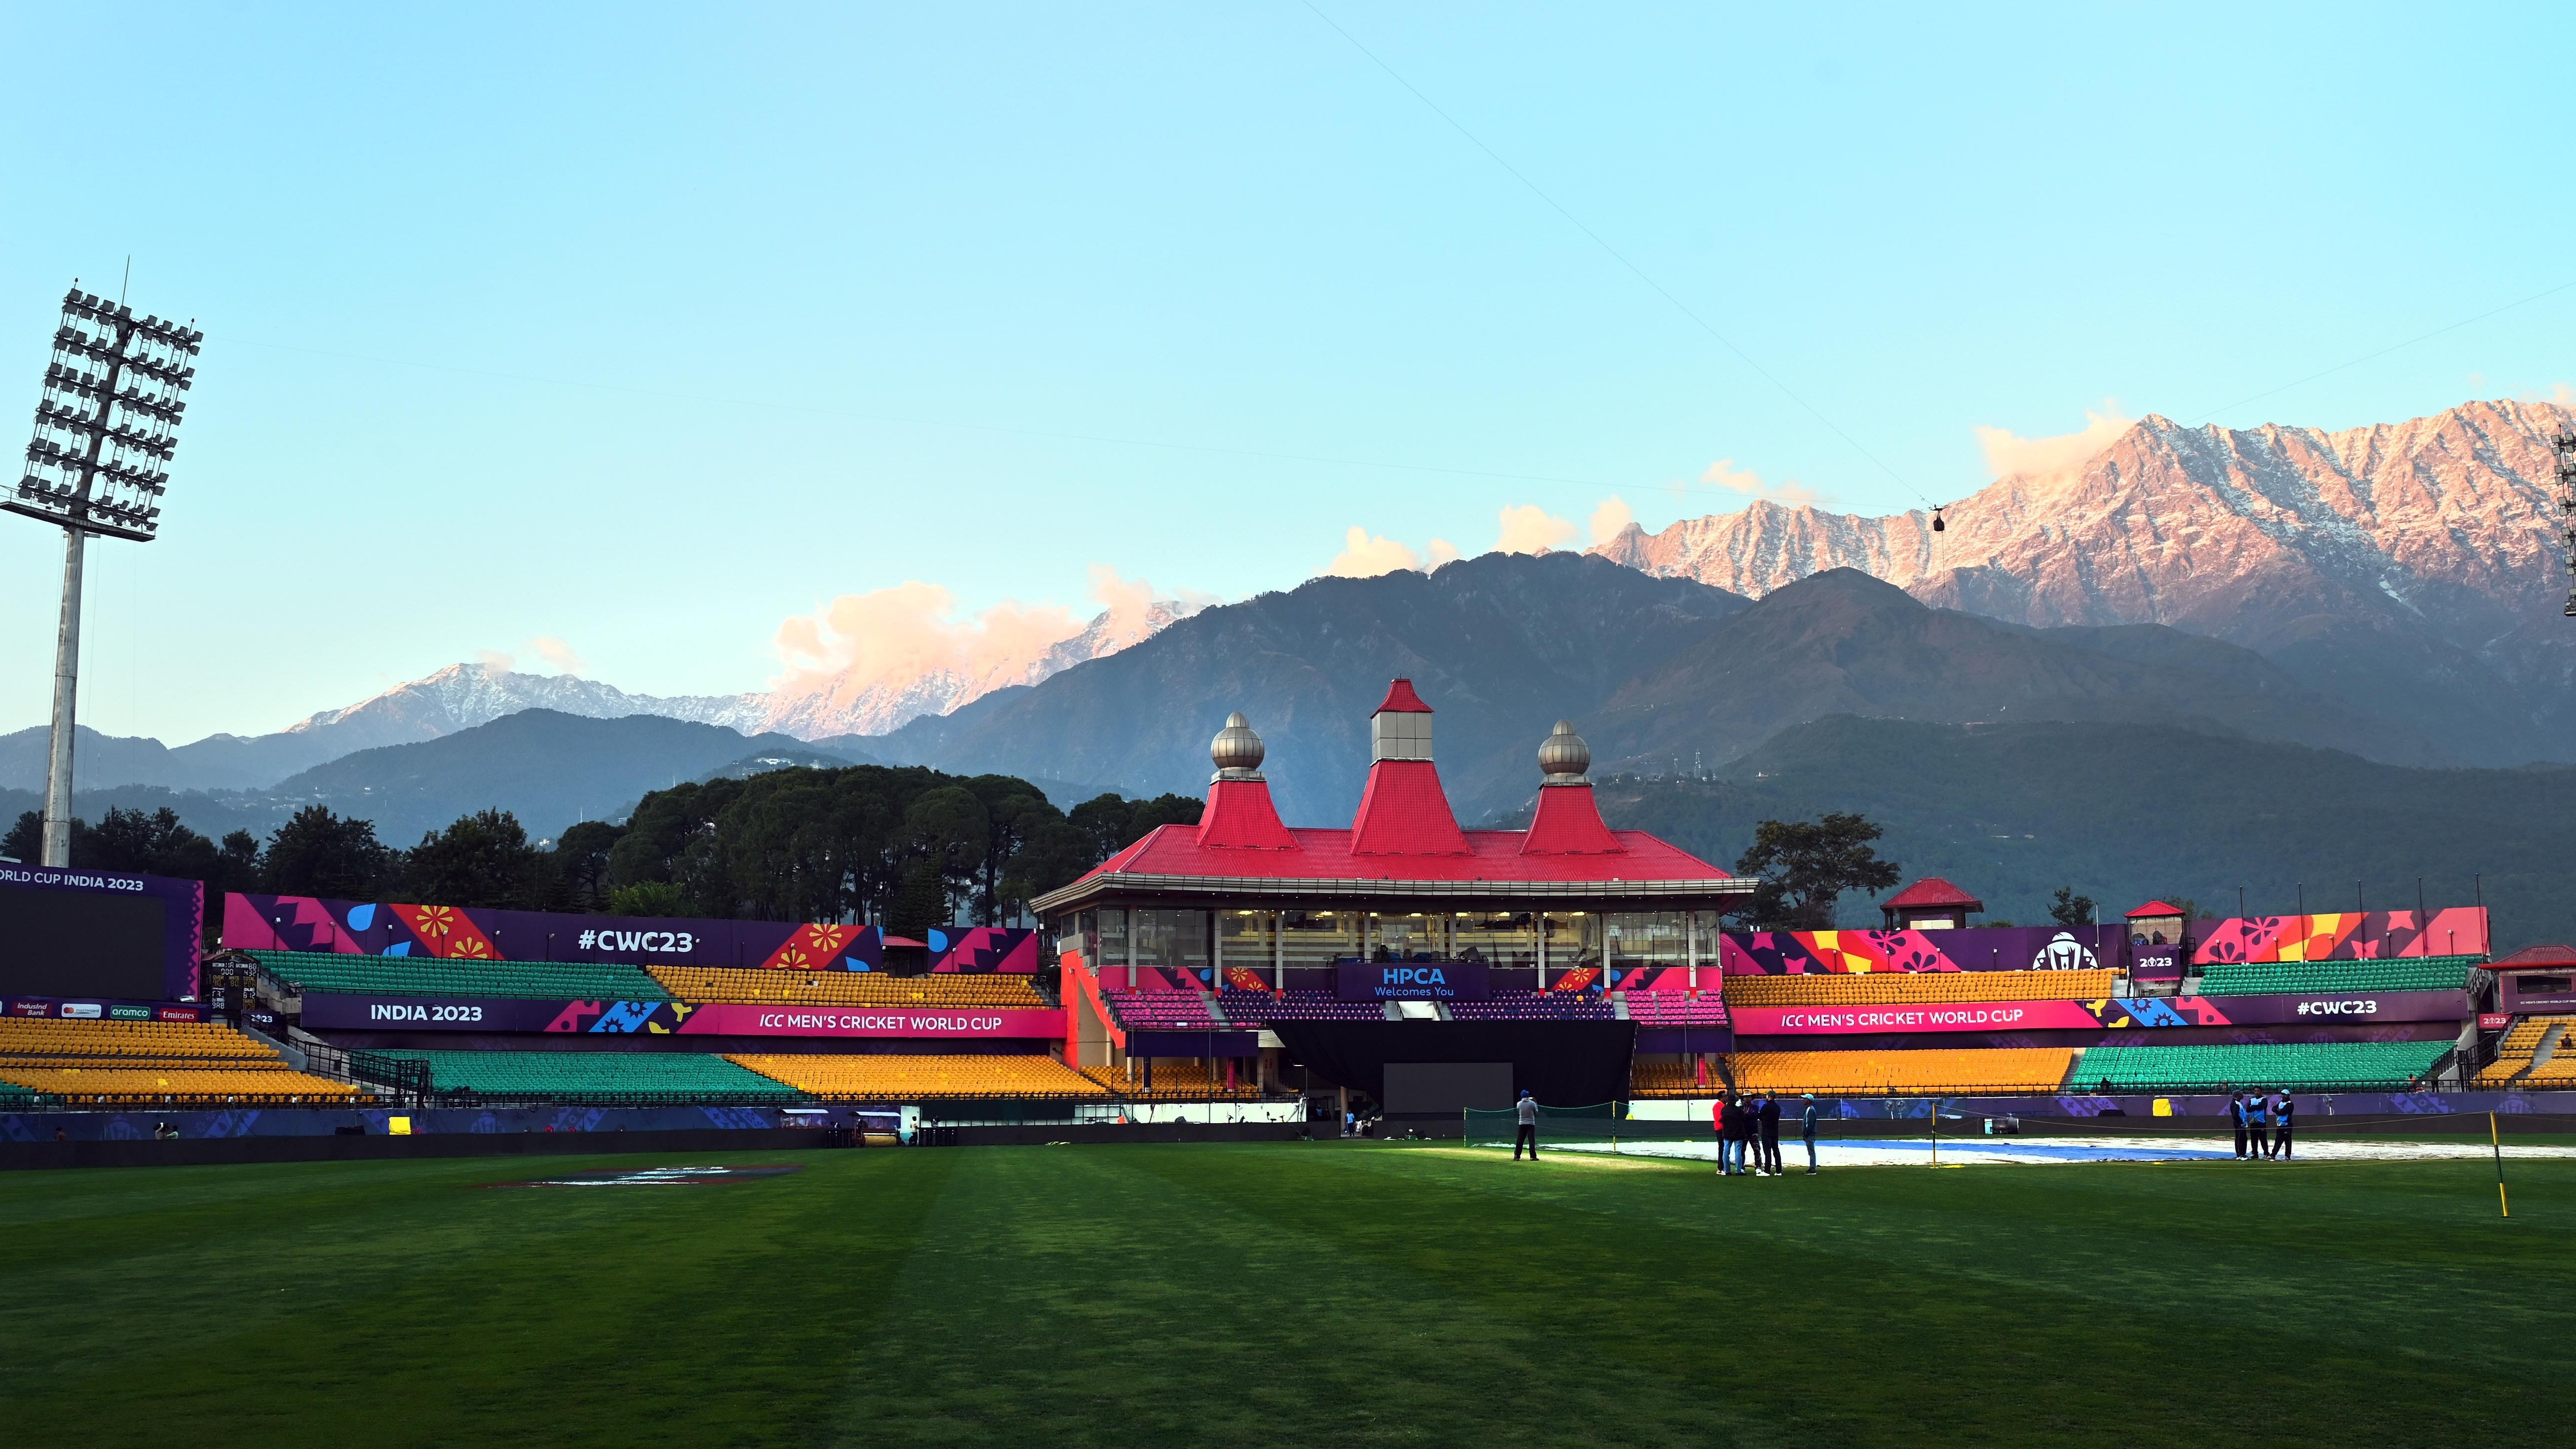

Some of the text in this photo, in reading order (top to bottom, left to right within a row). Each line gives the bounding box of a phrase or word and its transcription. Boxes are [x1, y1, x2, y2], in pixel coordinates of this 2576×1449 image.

[0, 869, 144, 891] ORLD CUP INDIA 2023
[578, 930, 692, 952] #CWC23
[1384, 969, 1445, 985] HPCA
[1375, 987, 1454, 996] Welcomes You
[163, 1011, 195, 1019] Emirates
[371, 1004, 482, 1021] INDIA 2023
[2297, 1000, 2377, 1015] #CWC23
[759, 1014, 1002, 1030] ICC MEN'S CRICKET WORLD CUP
[1781, 1009, 2023, 1027] ICC MEN'S CRICKET WORLD CUP
